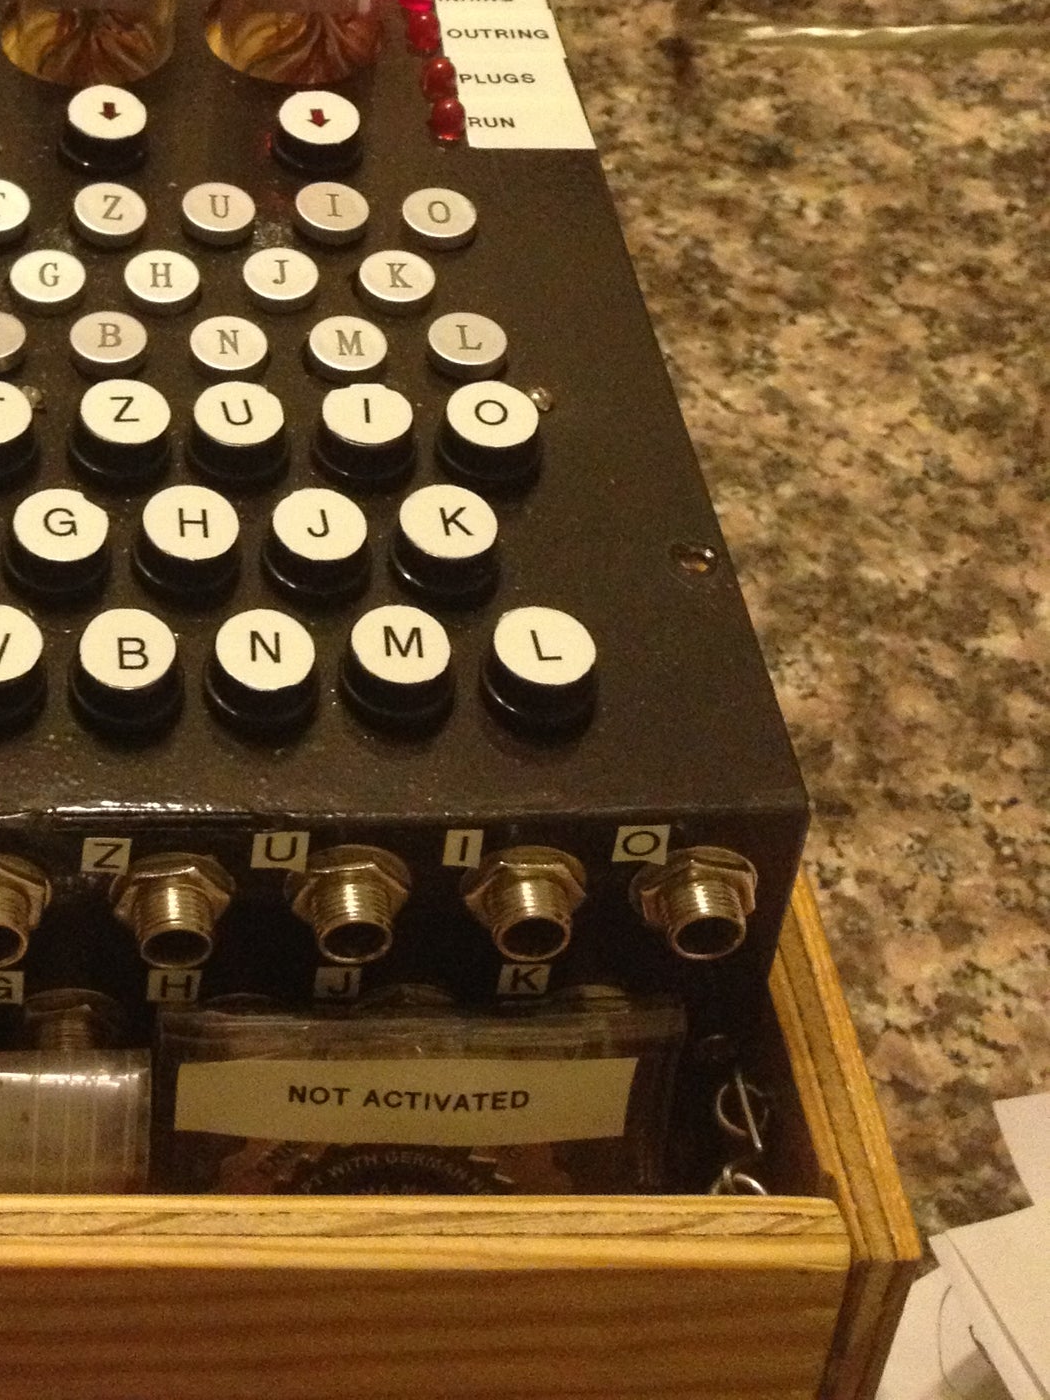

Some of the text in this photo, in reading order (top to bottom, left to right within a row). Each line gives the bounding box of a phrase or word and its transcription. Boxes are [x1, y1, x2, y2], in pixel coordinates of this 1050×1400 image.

[446, 28, 550, 39] OUTRING
[459, 73, 536, 84] PLUGS
[468, 116, 516, 128] RUN
[101, 194, 124, 222] Z
[208, 193, 230, 219] U
[325, 193, 343, 218] I
[427, 200, 452, 225] O
[38, 262, 60, 288] G
[149, 262, 173, 289] H
[272, 259, 289, 286] J
[386, 262, 413, 289] K
[97, 322, 123, 349] B
[216, 329, 240, 355] N
[335, 329, 365, 357] M
[455, 324, 483, 351] L
[109, 395, 140, 423] Z
[220, 398, 254, 427] U
[363, 397, 371, 424] I
[473, 399, 509, 427] O
[42, 507, 78, 538] G
[177, 507, 210, 539] H
[306, 508, 330, 538] J
[439, 506, 474, 537] K
[117, 636, 150, 671] B
[249, 630, 282, 664] N
[383, 625, 424, 659] M
[529, 629, 563, 662] L
[92, 842, 124, 870] Z
[264, 835, 298, 863] U
[458, 835, 469, 862] I
[621, 830, 662, 857] O
[161, 975, 194, 1001] H
[510, 967, 538, 991] K
[288, 1085, 530, 1111] NOT ACTIVATED
